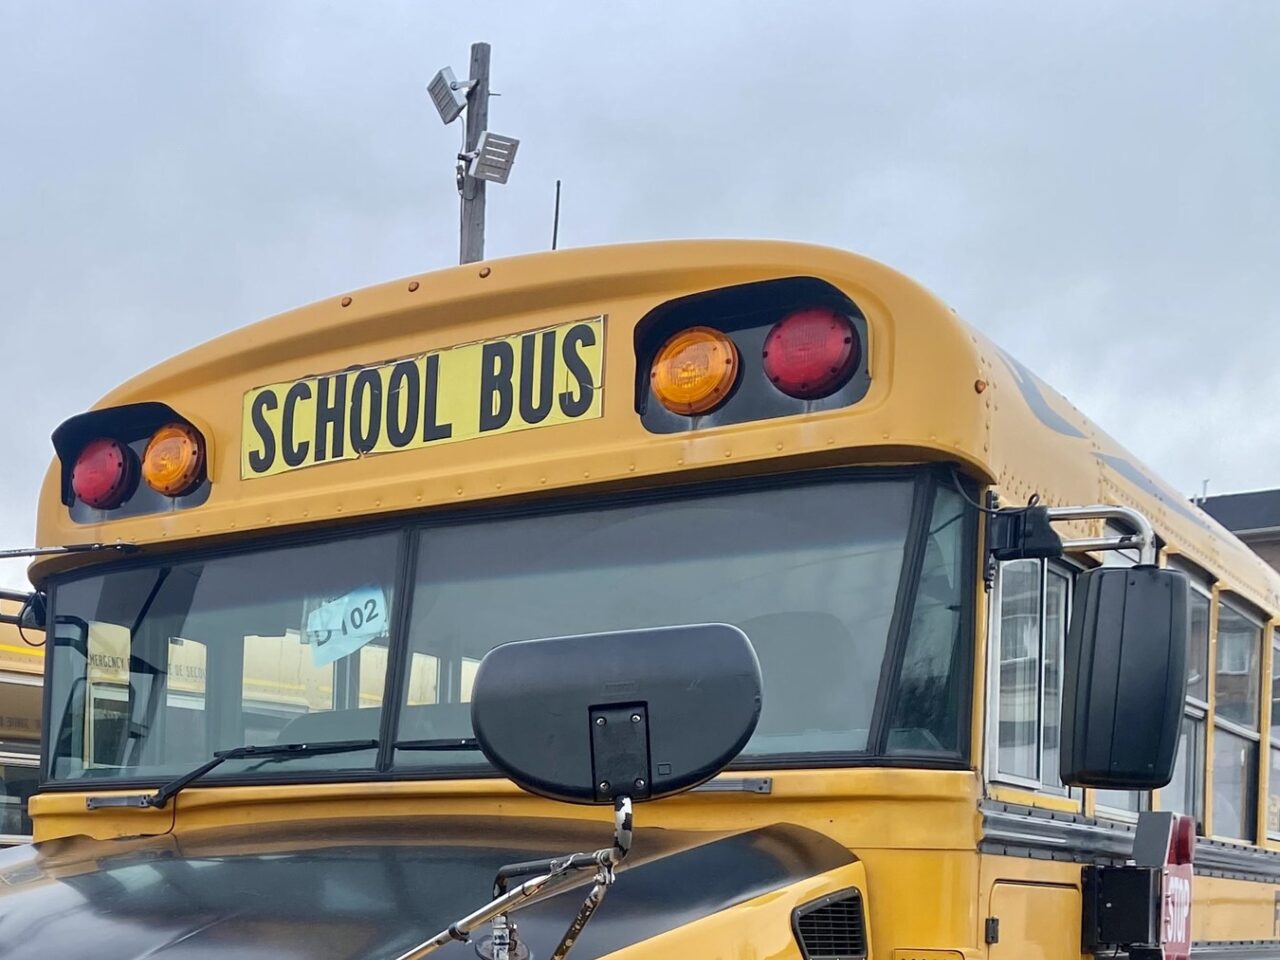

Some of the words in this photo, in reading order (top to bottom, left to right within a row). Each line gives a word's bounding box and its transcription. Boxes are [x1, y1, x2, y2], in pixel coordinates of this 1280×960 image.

[248, 354, 453, 473] SCHOOL
[479, 324, 597, 433] BUS
[88, 653, 124, 669] MERGENCY
[1167, 876, 1191, 944] STOP
